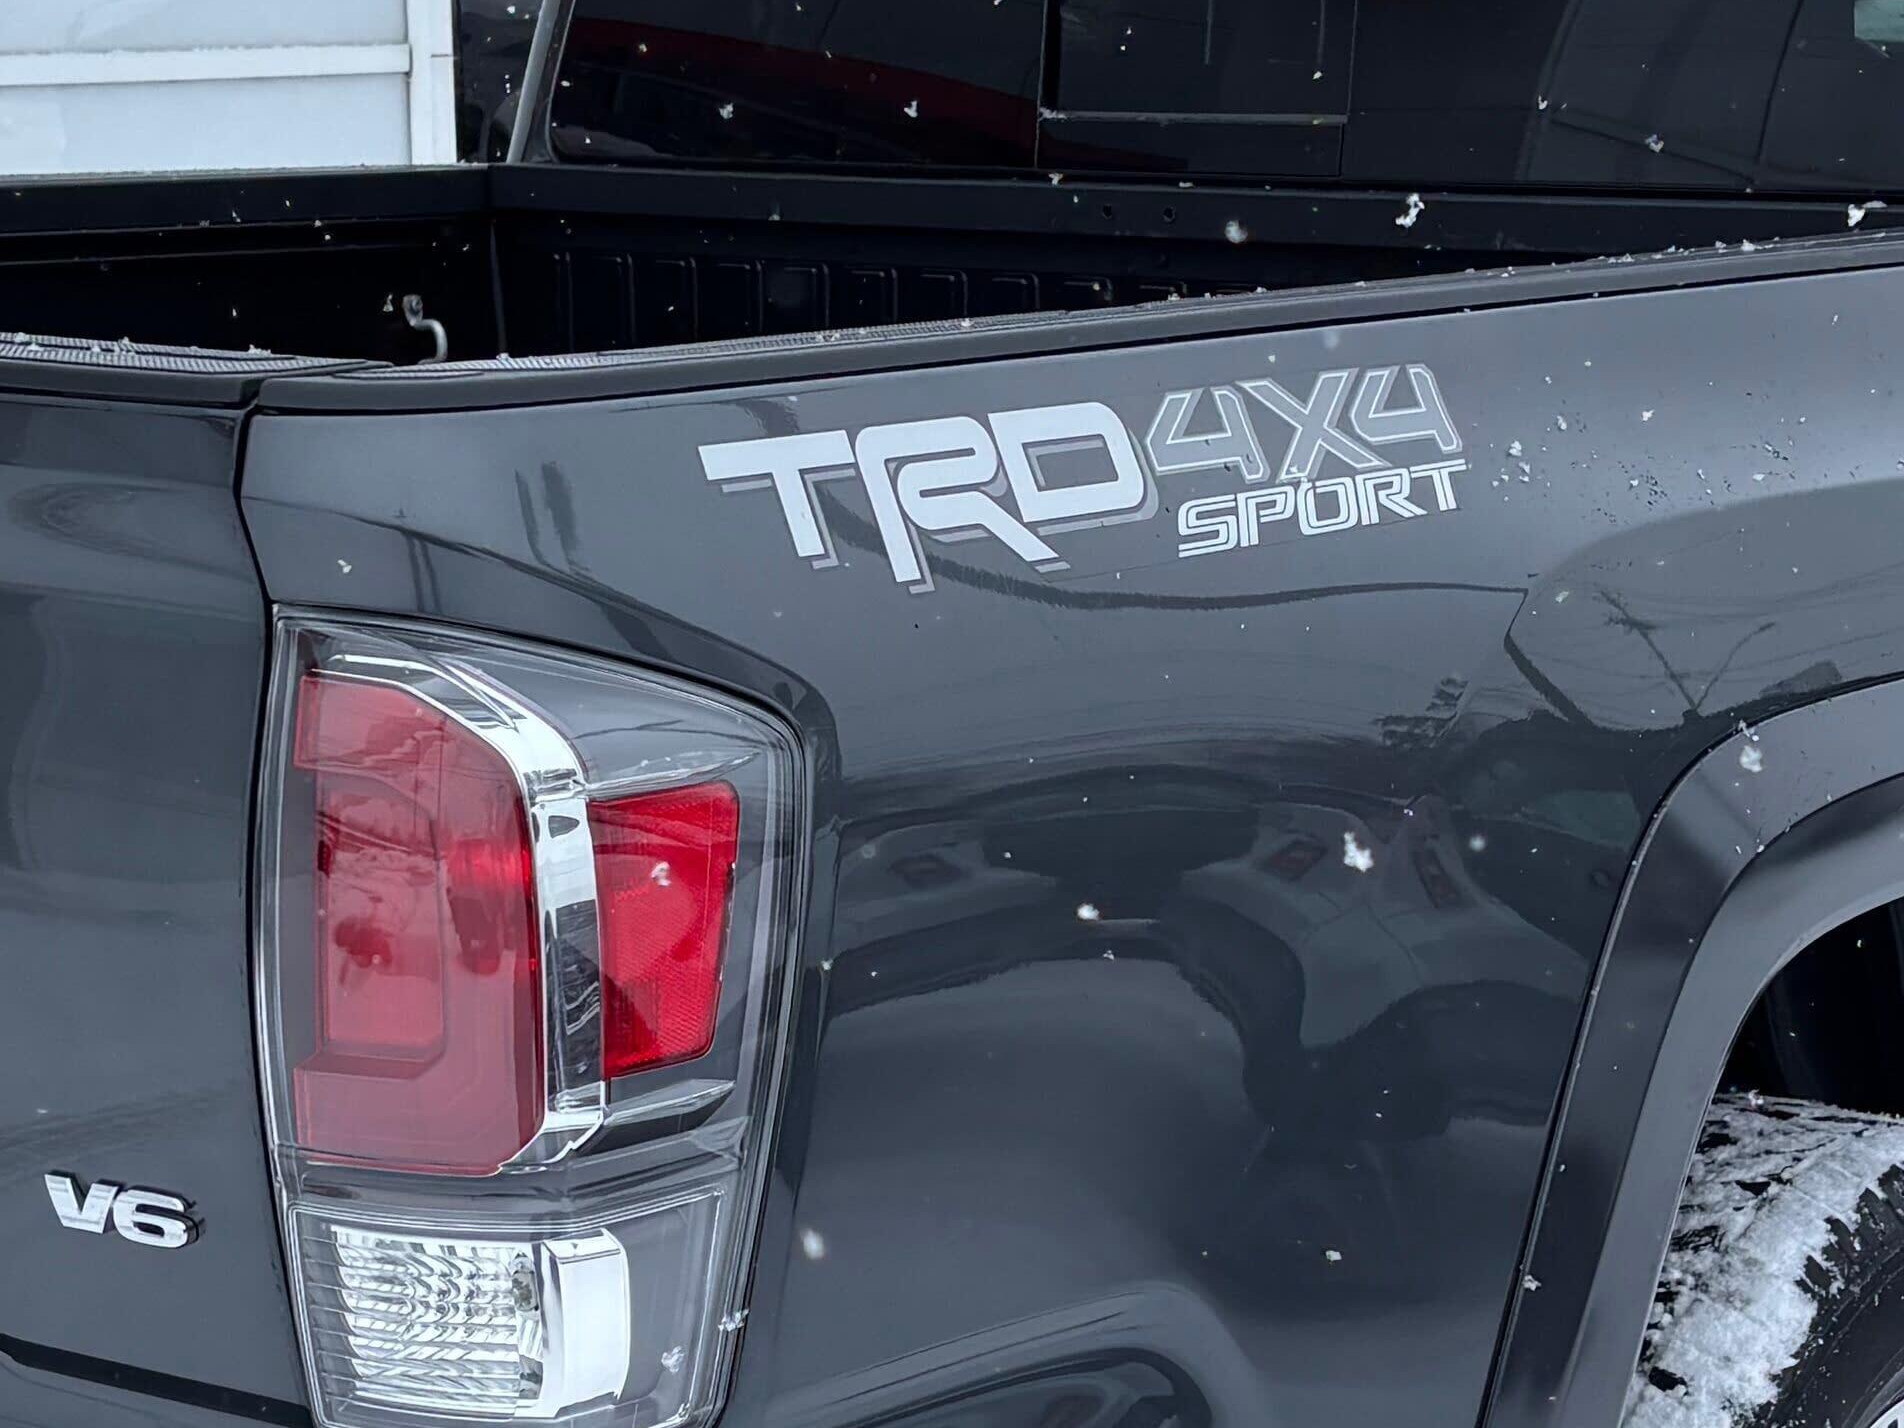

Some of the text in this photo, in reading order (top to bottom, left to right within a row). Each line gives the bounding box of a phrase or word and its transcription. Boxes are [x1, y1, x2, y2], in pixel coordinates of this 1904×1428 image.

[698, 402, 1156, 590] TRD
[1178, 459, 1467, 559] SPORT
[45, 1170, 200, 1248] V6
